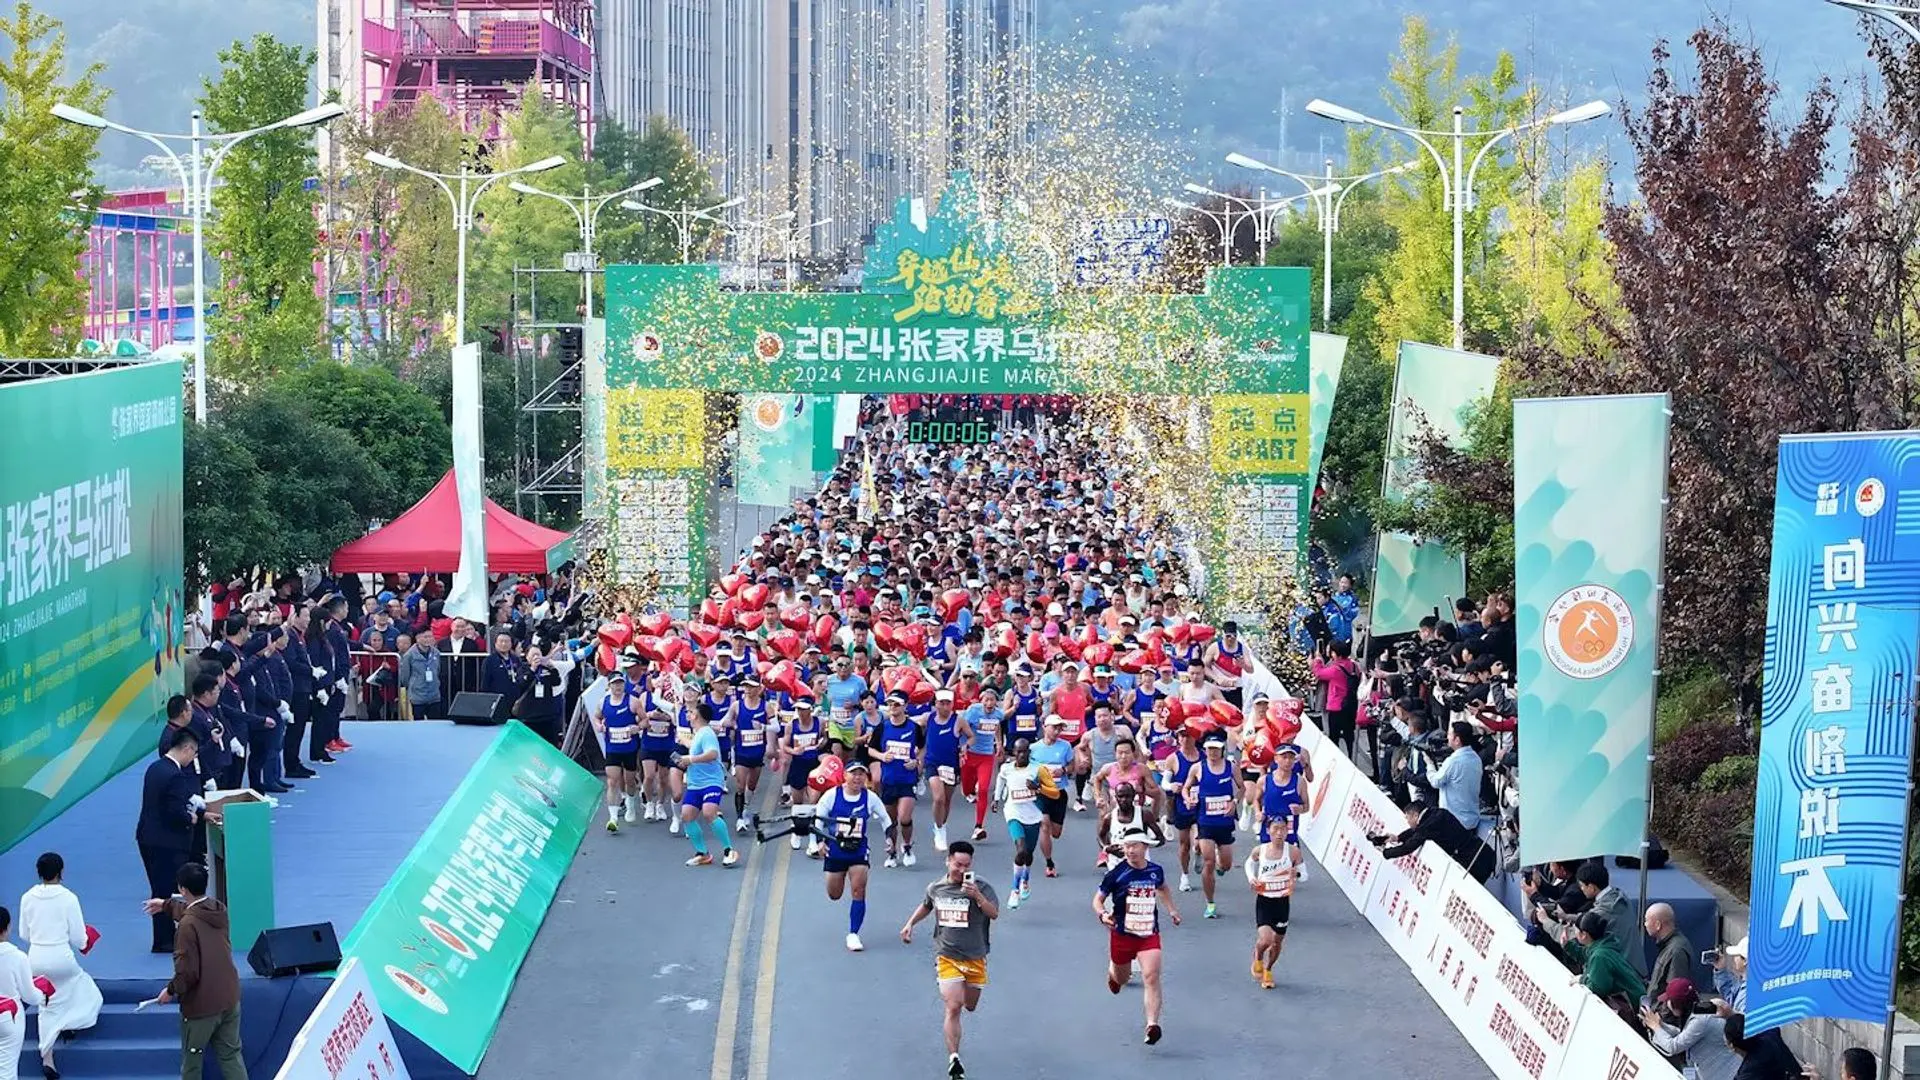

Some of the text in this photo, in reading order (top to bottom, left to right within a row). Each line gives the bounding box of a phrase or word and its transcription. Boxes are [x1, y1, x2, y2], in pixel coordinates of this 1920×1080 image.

[795, 325, 1118, 363] 2024张家界马
[794, 365, 842, 384] 2024
[855, 366, 990, 384] ZHANGJIAJIE
[909, 421, 990, 443] 0:00:06
[0, 467, 132, 608] 张家界马拉松
[55, 587, 88, 618] MARATHON
[1426, 933, 1478, 1006] 人民政府
